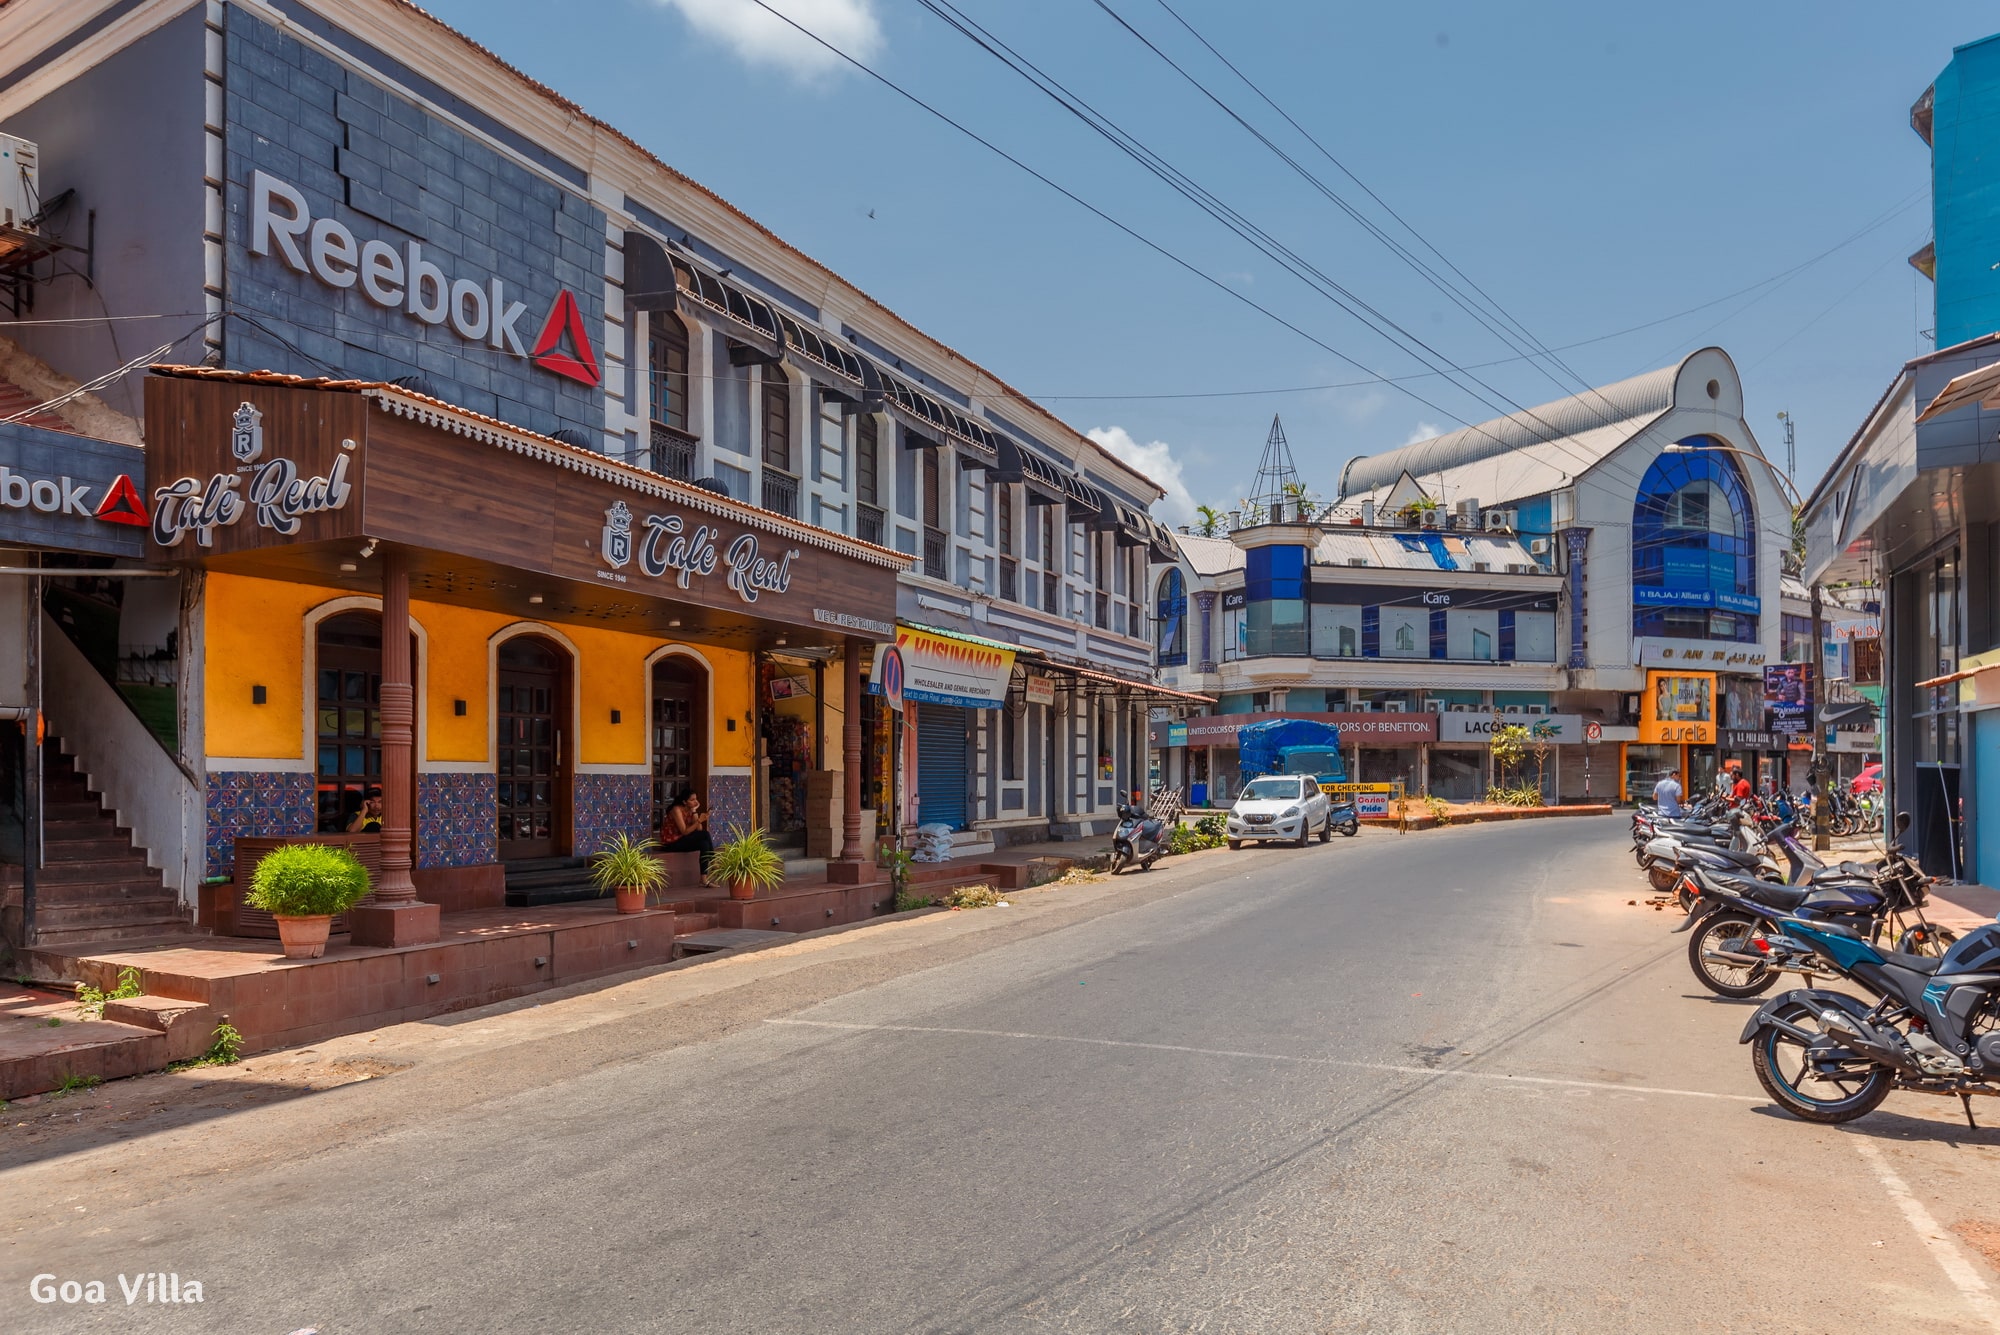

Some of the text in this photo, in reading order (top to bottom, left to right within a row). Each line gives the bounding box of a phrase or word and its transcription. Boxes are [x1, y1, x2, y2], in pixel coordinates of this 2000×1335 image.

[249, 169, 527, 359] Reebok
[238, 435, 250, 452] R
[0, 466, 92, 517] bok
[153, 453, 351, 547] Café Real
[614, 538, 625, 556] R
[639, 514, 792, 603] Café Real
[597, 571, 614, 582] SINCE
[1225, 593, 1243, 606] iCare
[1423, 591, 1450, 605] iCare
[1648, 591, 1702, 600] BAJAJ Allianz
[838, 613, 895, 635] RESTAURANT
[913, 636, 1003, 673] KUSUMAKAR
[1663, 648, 1703, 660] OAN
[914, 678, 943, 690] WHOLESALER
[944, 682, 953, 692] AND
[1189, 727, 1206, 736] UNITED
[1207, 725, 1227, 735] COLORS
[1228, 724, 1237, 734] OF
[1363, 722, 1376, 732] OF
[1661, 723, 1707, 742] aurelia
[1746, 732, 1756, 743] POLO
[1337, 784, 1374, 792] CHECKING
[1357, 796, 1386, 804] Casino
[1361, 804, 1382, 813] Pride
